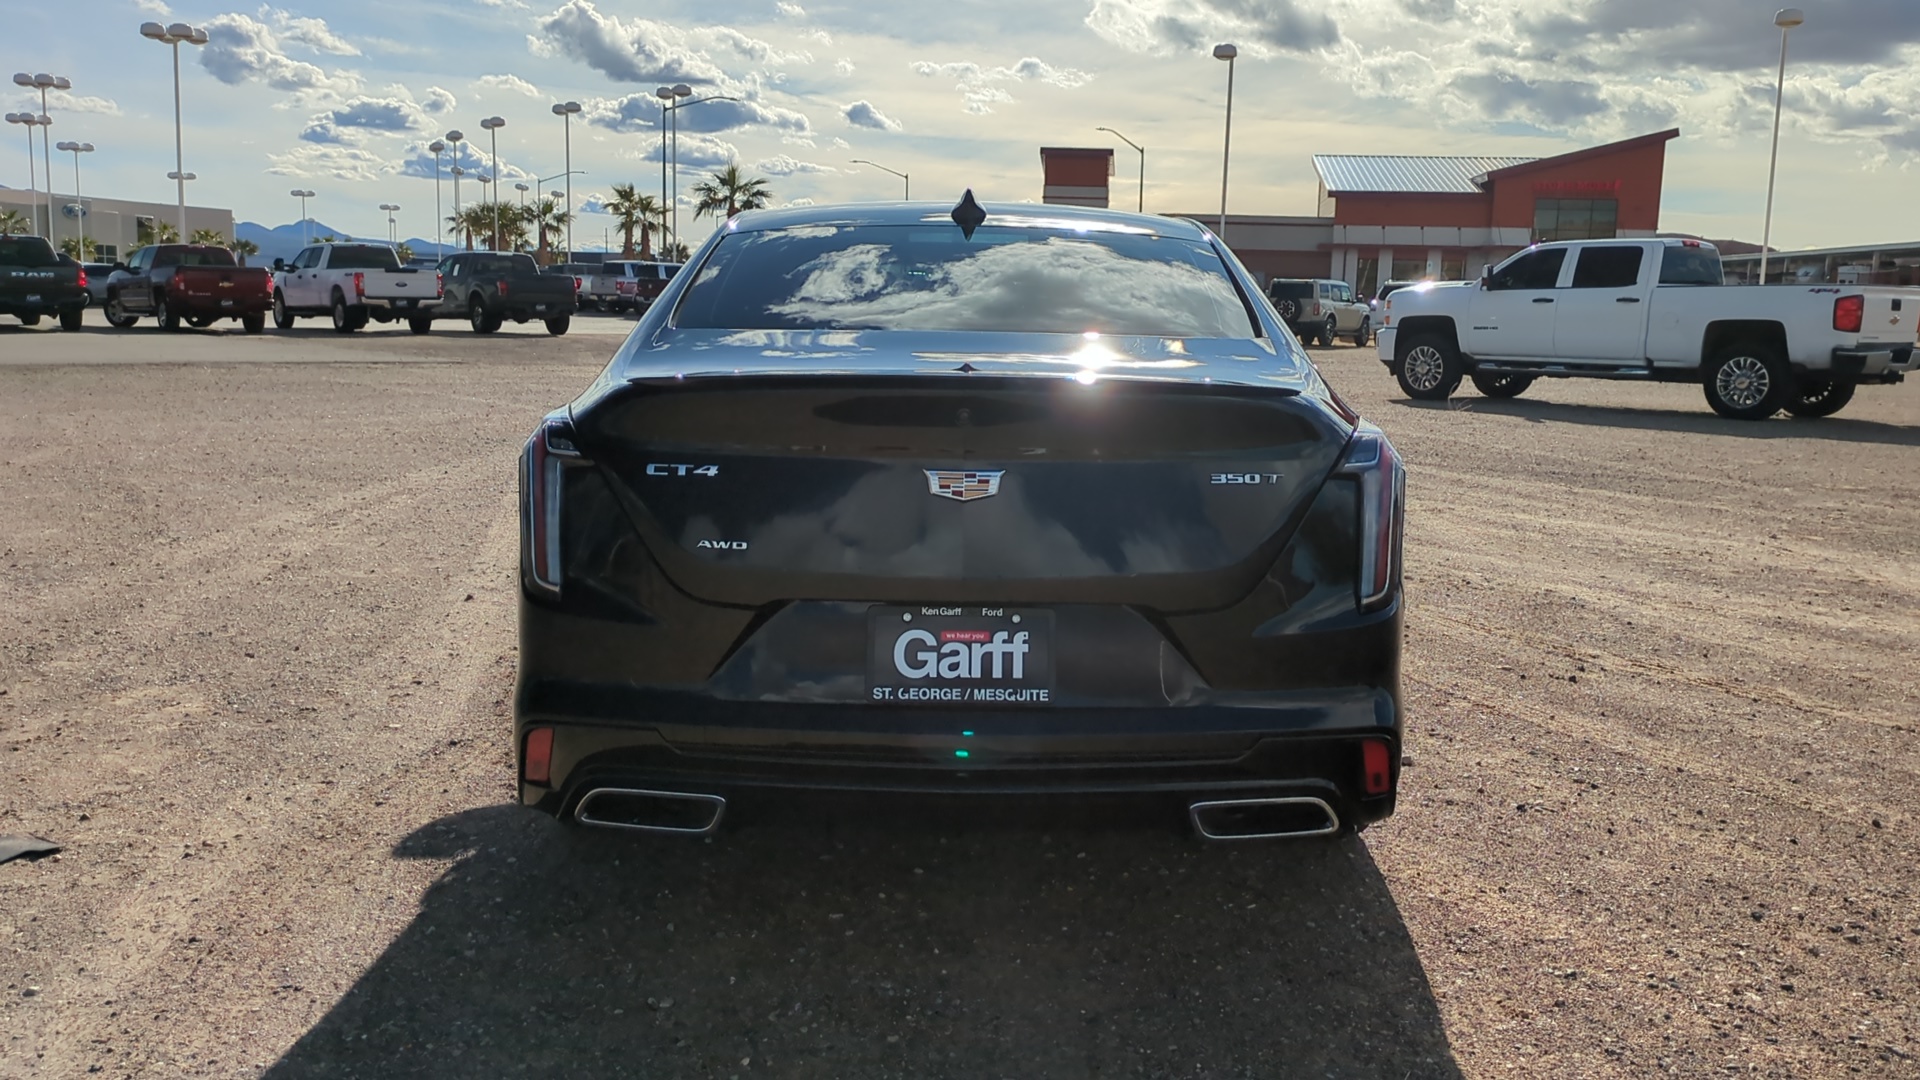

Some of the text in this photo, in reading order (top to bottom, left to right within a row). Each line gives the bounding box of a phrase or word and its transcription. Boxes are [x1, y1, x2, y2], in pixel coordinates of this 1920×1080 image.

[646, 463, 719, 477] CT4
[696, 539, 748, 550] AWD
[921, 607, 1003, 617] Ken Garff Ford
[956, 631, 970, 639] hear
[971, 633, 984, 641] you
[893, 629, 1029, 679] Garff
[872, 687, 1049, 702] ST. GEORGE / MESQUITE
